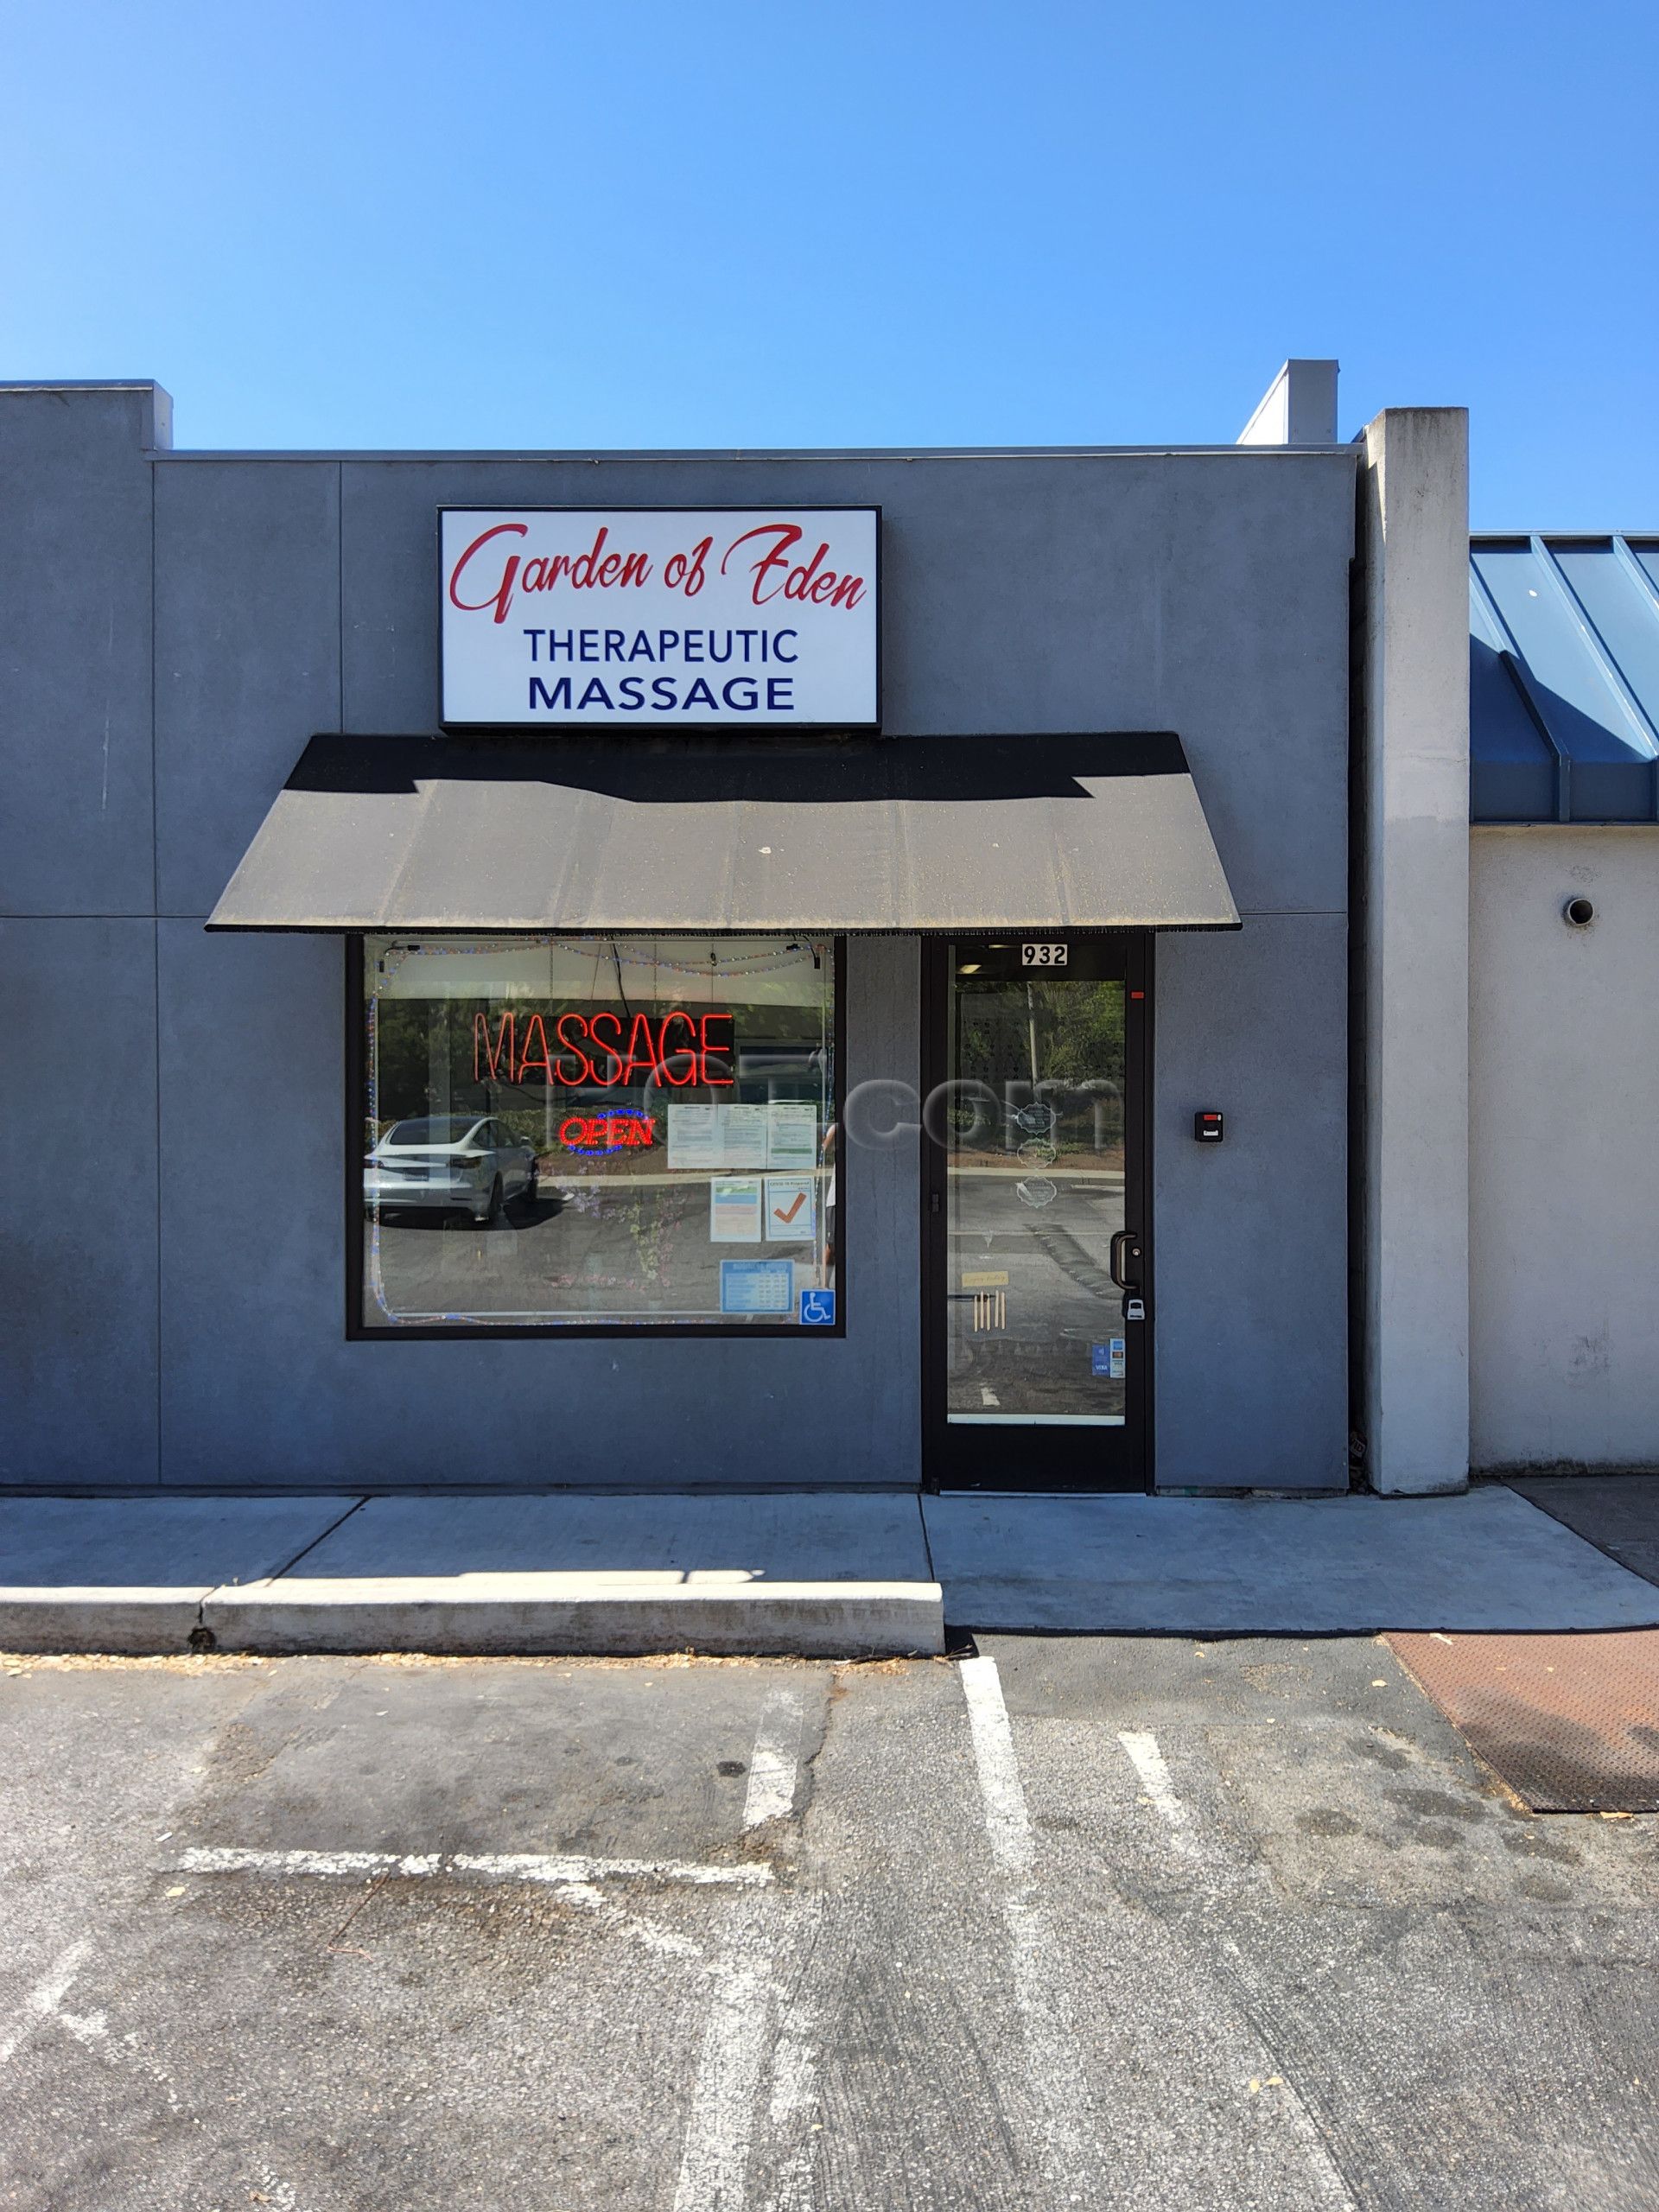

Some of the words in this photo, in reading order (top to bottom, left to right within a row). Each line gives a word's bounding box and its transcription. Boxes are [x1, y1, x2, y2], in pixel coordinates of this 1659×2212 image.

[449, 523, 653, 624] Garden
[664, 536, 714, 597] of
[721, 524, 868, 610] Eden
[523, 629, 799, 663] THERAPEUTIC
[528, 677, 795, 711] MASSAGE
[1023, 945, 1065, 964] 932
[474, 1011, 734, 1087] MASSAGE
[558, 1116, 656, 1147] OPEN
